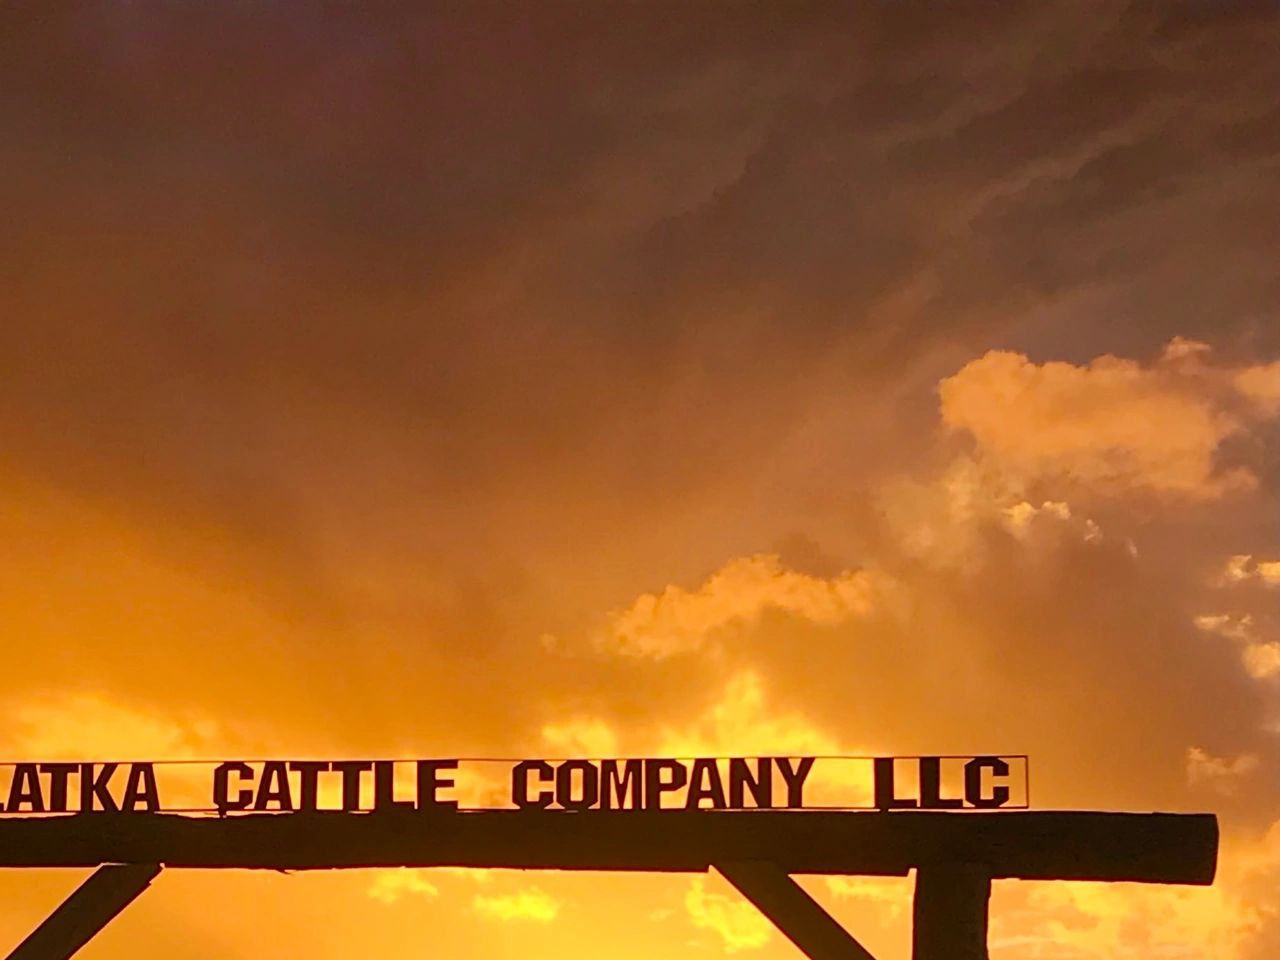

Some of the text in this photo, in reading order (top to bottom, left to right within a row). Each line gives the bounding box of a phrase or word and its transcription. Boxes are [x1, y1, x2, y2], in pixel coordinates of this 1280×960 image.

[214, 761, 458, 812] CATTLE
[512, 758, 814, 810] COMPANY
[874, 757, 1011, 808] LLC
